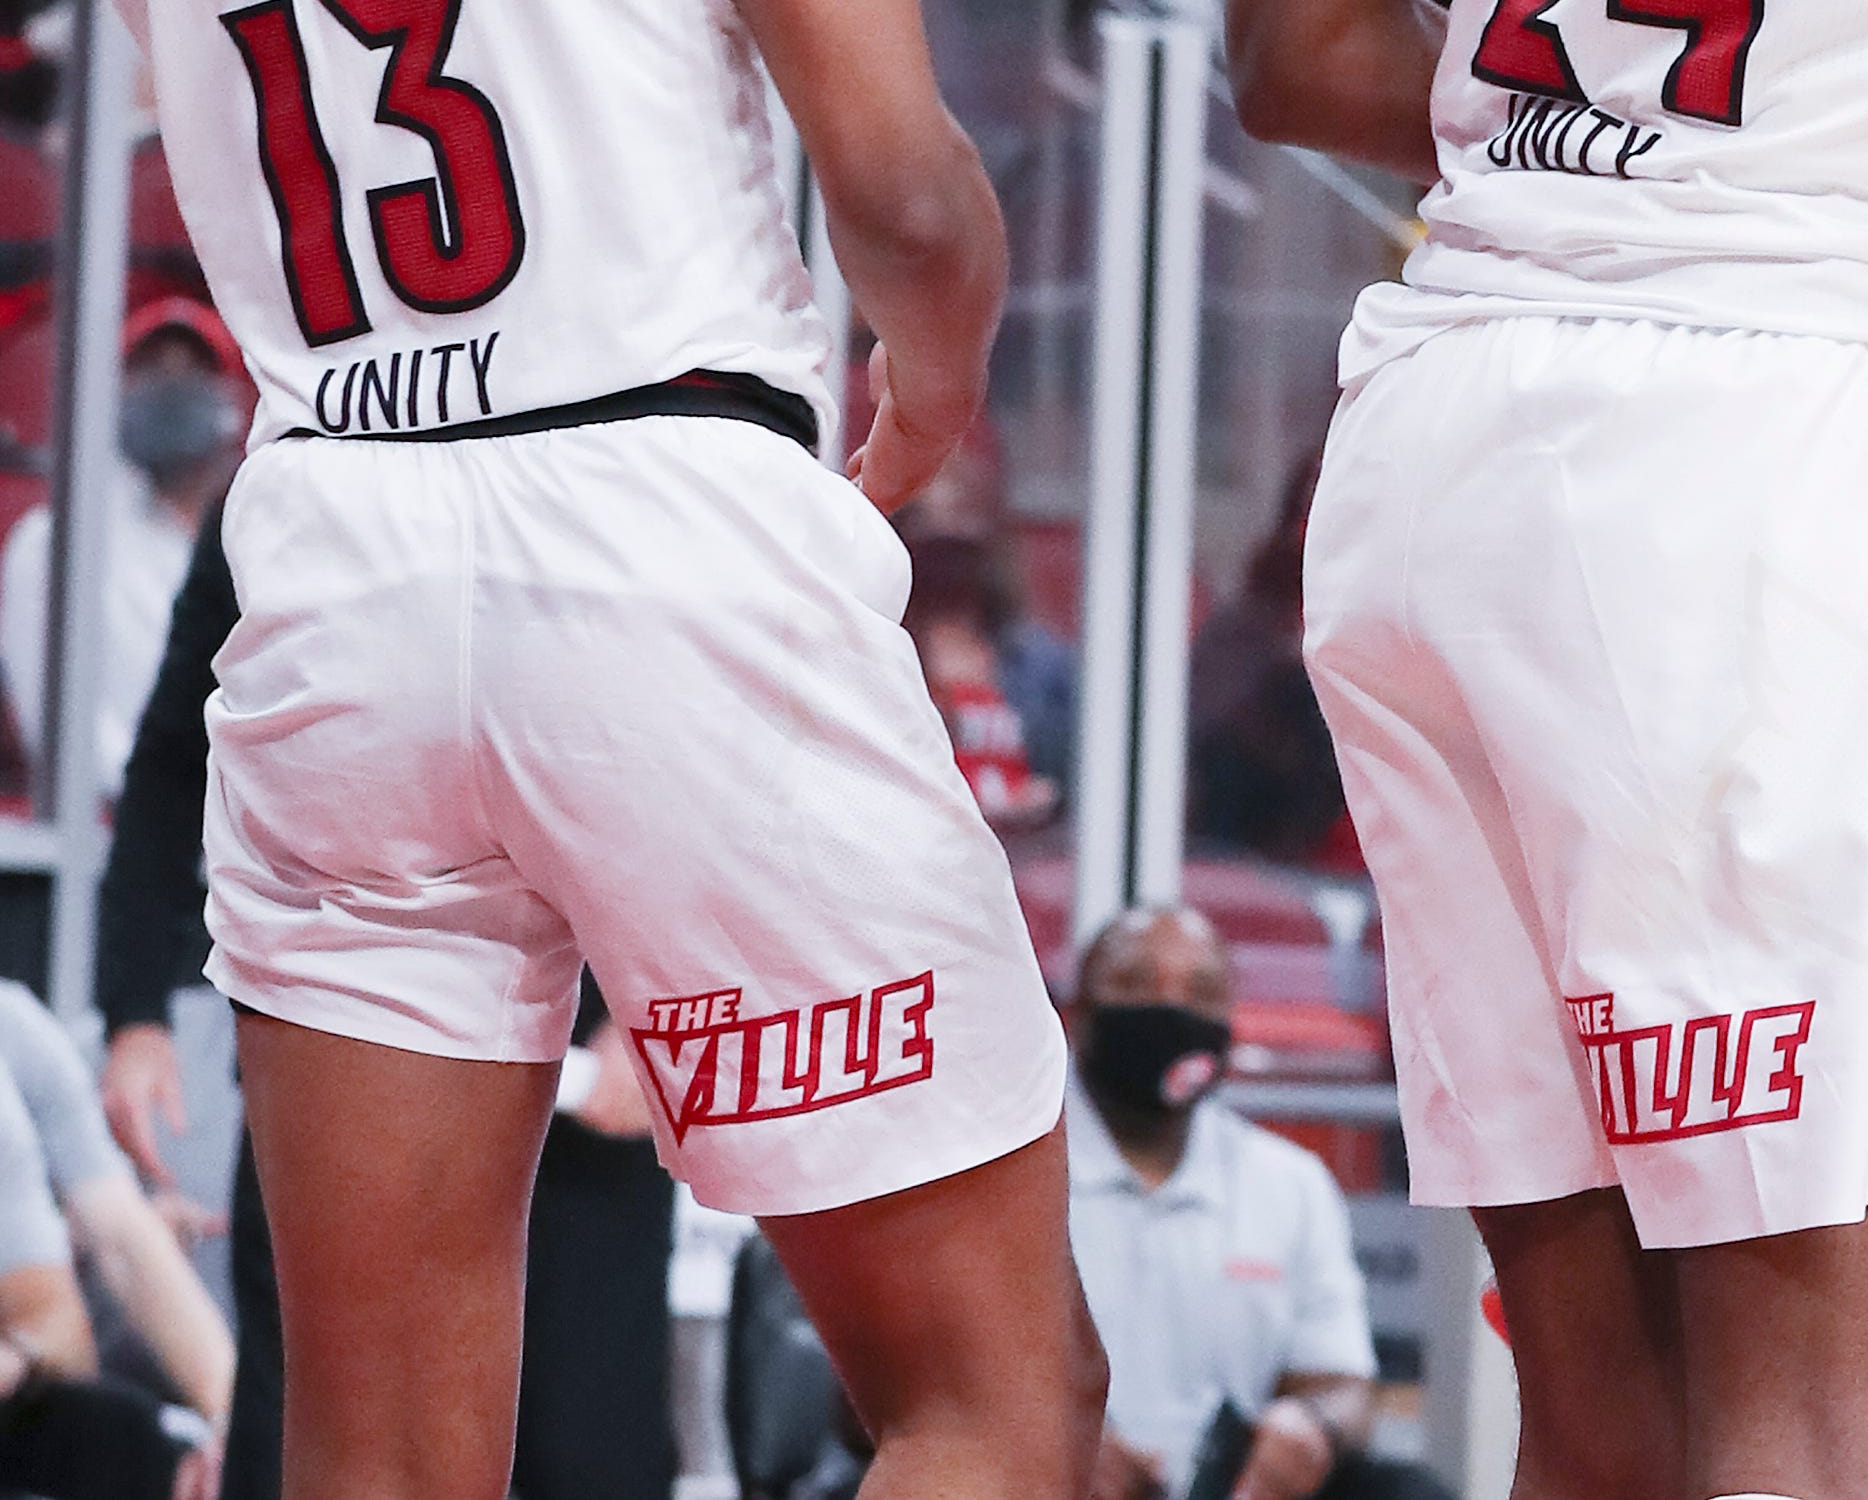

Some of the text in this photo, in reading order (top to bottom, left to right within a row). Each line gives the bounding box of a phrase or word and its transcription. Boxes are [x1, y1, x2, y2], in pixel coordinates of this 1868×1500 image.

[1487, 93, 1662, 180] UNITY
[315, 331, 500, 435] UNITY
[629, 970, 935, 1148] VILLE
[648, 988, 742, 1034] THE
[1585, 1000, 1816, 1145] ILLE
